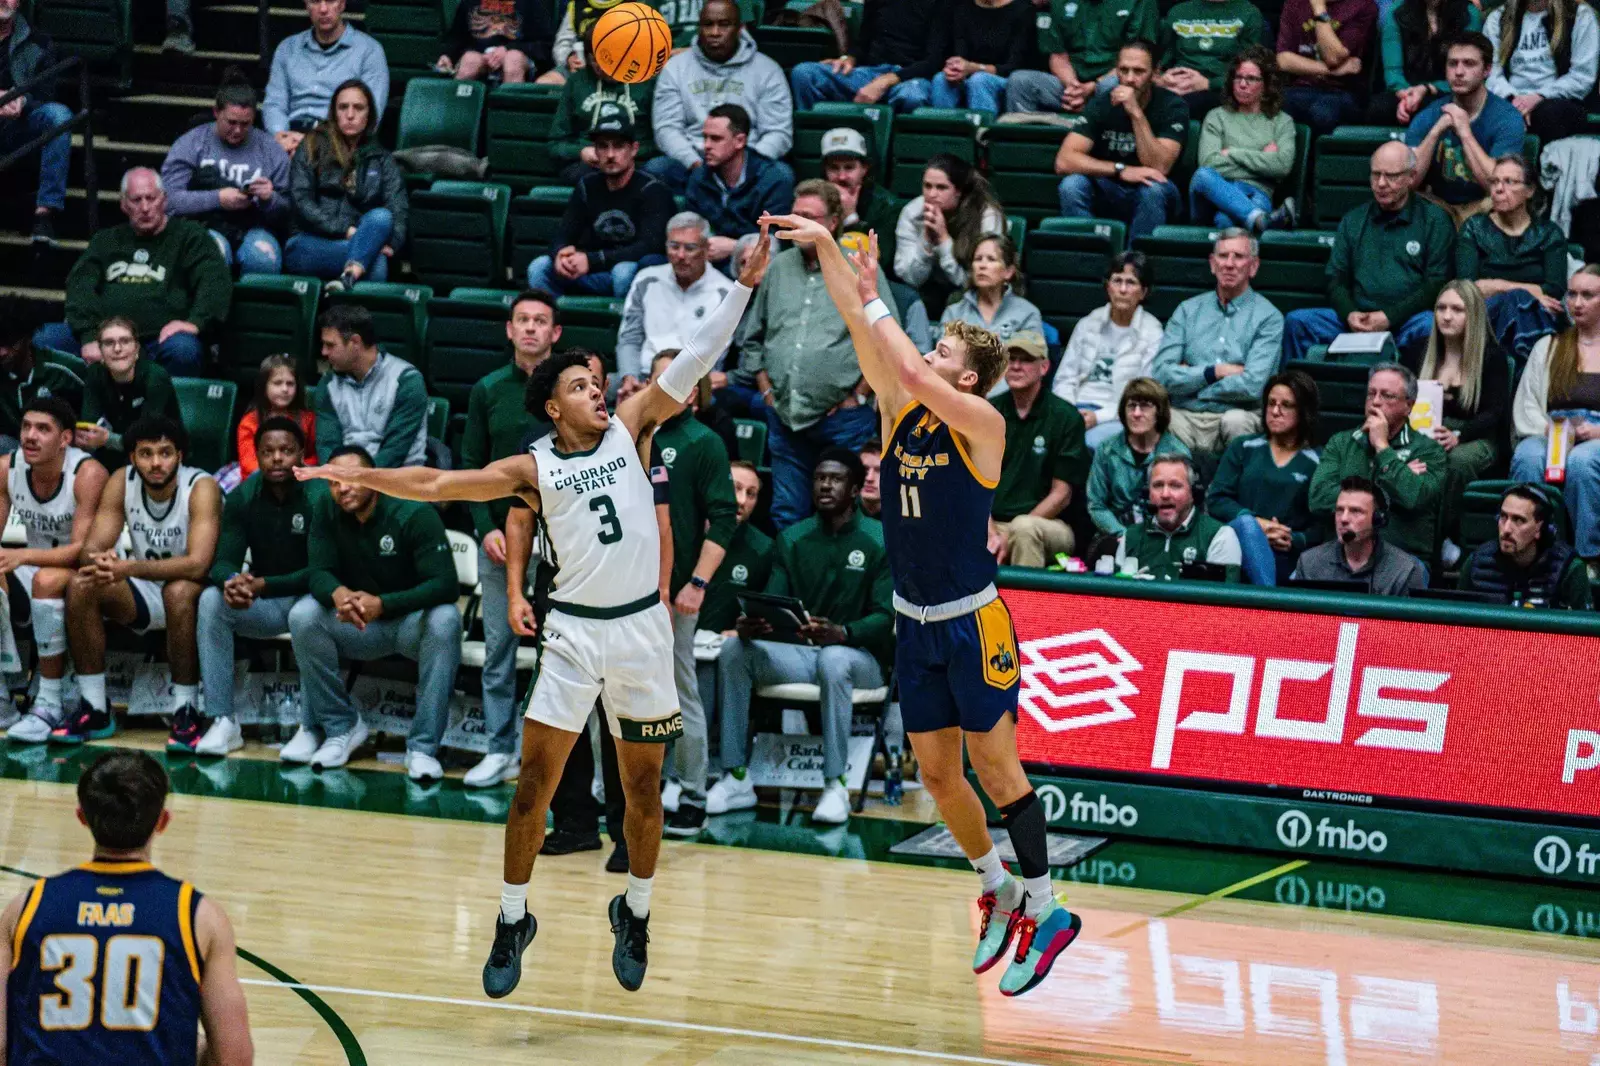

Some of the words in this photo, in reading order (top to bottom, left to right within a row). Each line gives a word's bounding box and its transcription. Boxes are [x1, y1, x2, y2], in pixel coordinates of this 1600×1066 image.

[554, 456, 627, 491] COLORADO
[573, 473, 617, 495] STATE
[899, 464, 930, 480] ITY
[900, 483, 922, 518] 11
[588, 494, 623, 546] 3
[1150, 621, 1452, 770] pds
[641, 715, 684, 737] RAMS
[1069, 791, 1139, 828] fnbo
[1302, 789, 1373, 805] DAKTRONICS
[1316, 817, 1388, 854] fnbo
[77, 901, 136, 927] FAAS
[38, 933, 166, 1032] 30
